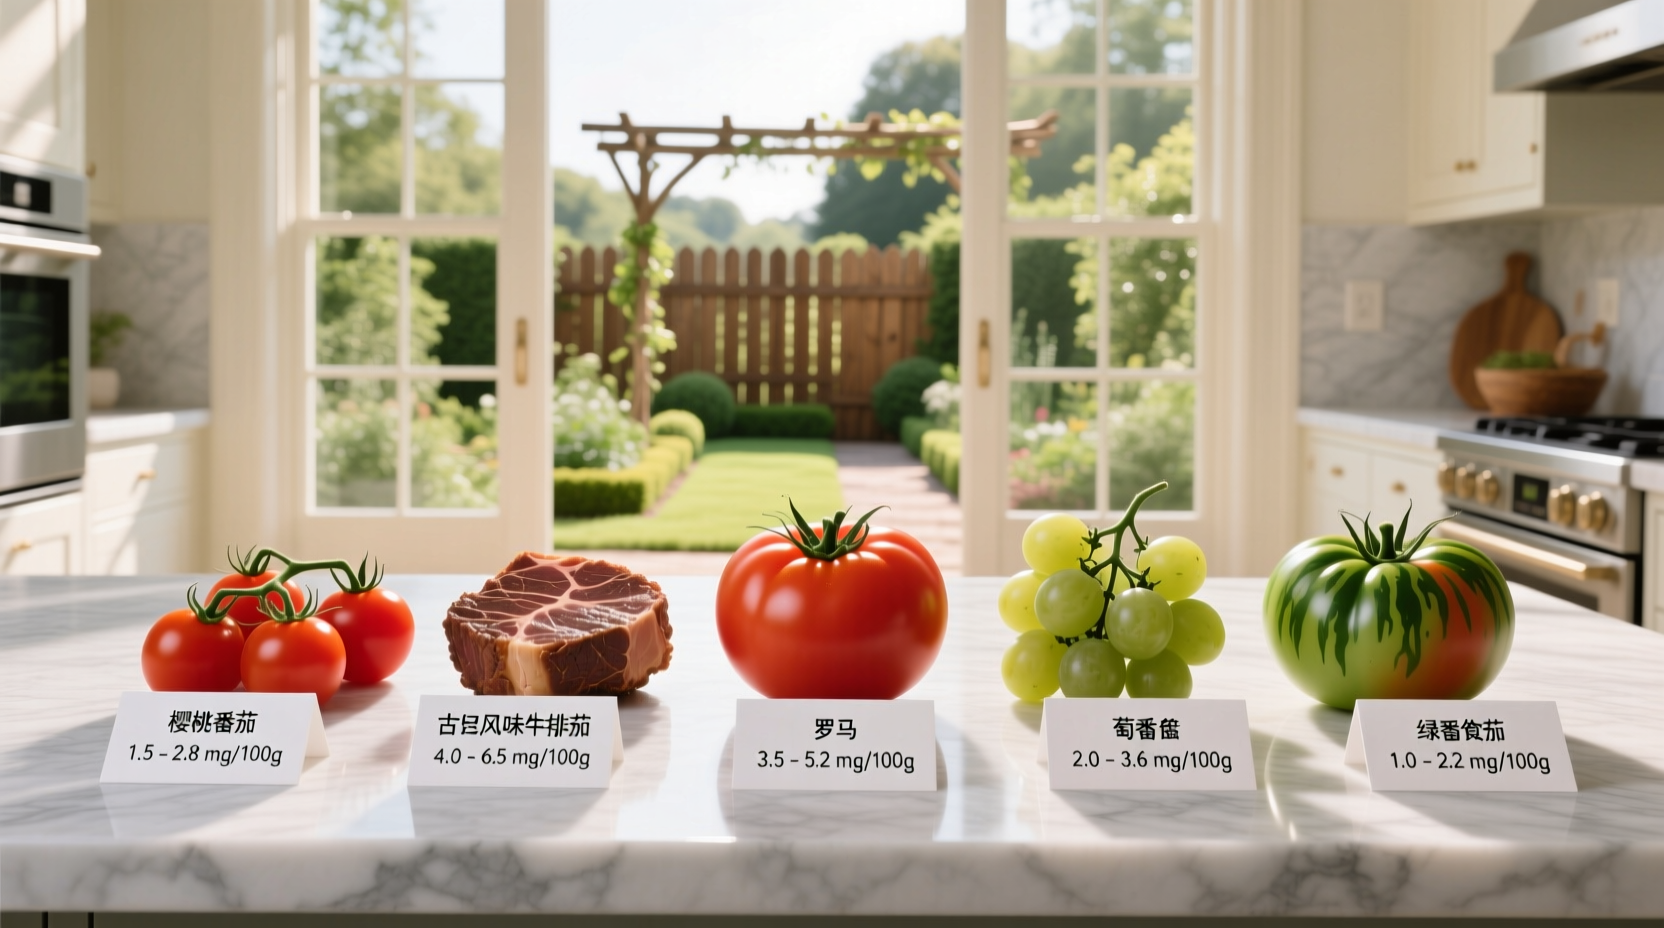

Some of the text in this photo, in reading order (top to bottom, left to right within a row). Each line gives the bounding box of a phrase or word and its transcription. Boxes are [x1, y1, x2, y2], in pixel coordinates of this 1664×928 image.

[814, 718, 857, 740] 罗马
[129, 744, 154, 761] 1.5
[171, 745, 199, 761] 2.8
[204, 744, 283, 767] mg/100g
[433, 747, 462, 765] 4.0
[481, 748, 507, 765] 6.5
[512, 747, 590, 770] mg/100g
[757, 750, 785, 768] 3.5
[804, 751, 831, 768] 5.2
[836, 750, 915, 774] mg/100g
[1072, 750, 1100, 768] 2.0
[1121, 750, 1148, 768] 3.6
[1153, 750, 1233, 774] mg/100g
[1390, 751, 1417, 768] 1.0
[1436, 751, 1465, 768] 2.2
[1469, 751, 1551, 775] mg/100g
